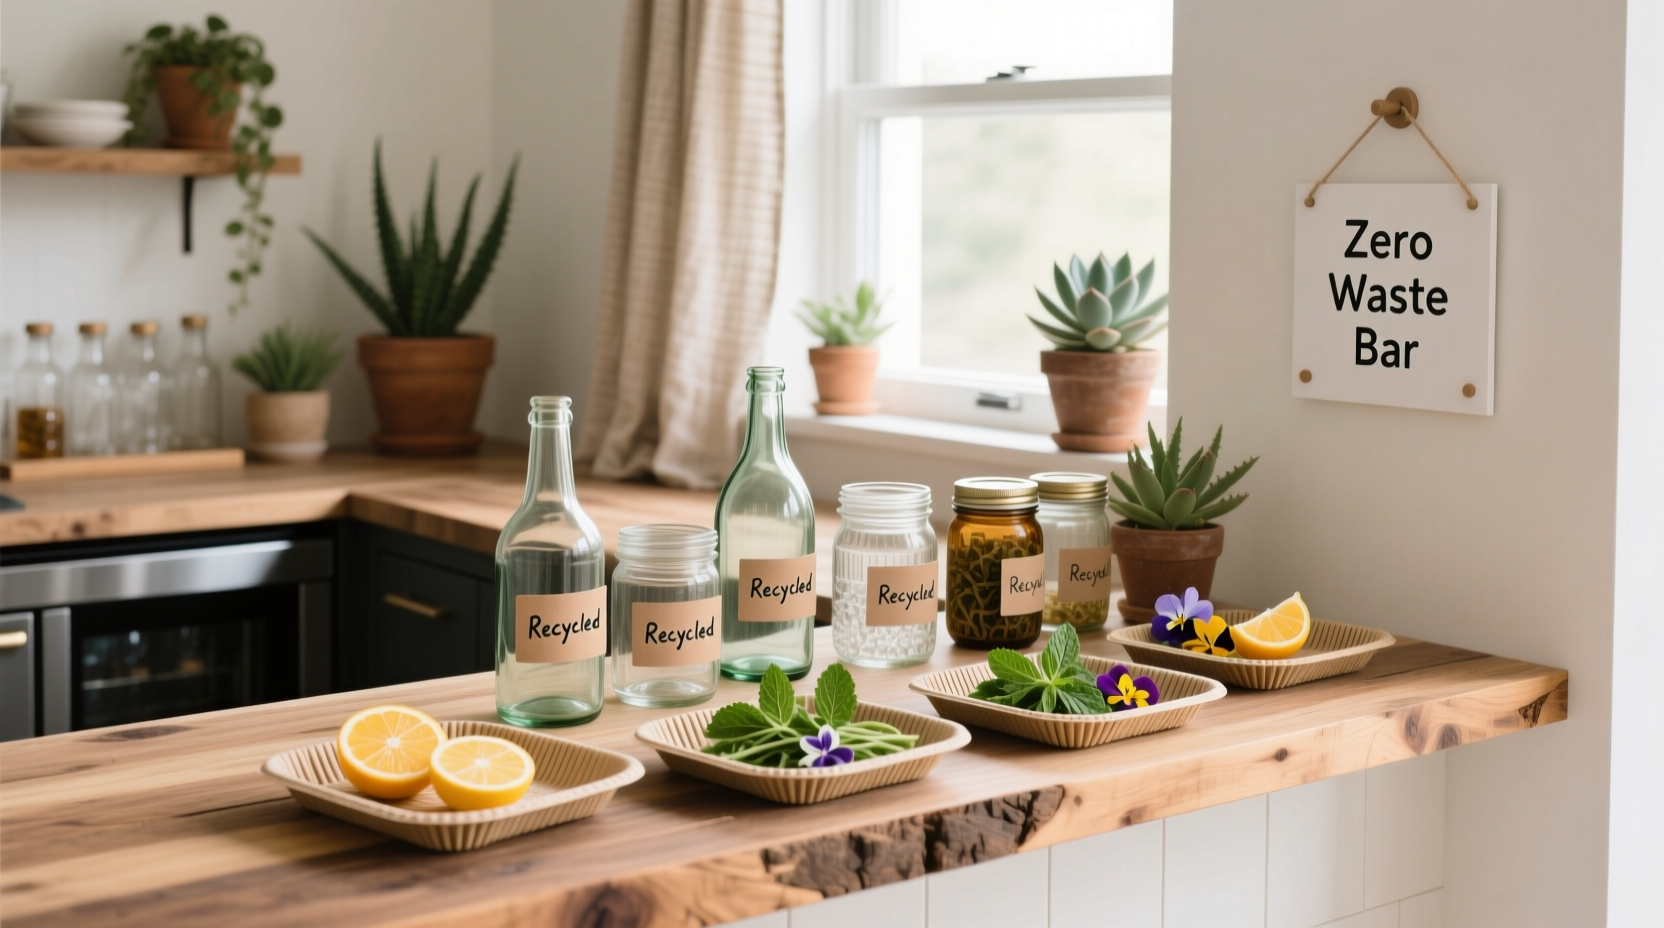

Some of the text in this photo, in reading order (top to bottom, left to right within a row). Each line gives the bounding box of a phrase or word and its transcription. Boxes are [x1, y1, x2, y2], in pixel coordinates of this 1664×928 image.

[1344, 219, 1433, 260] Zero
[1328, 272, 1448, 316] Waste
[1355, 326, 1419, 369] Bar
[750, 572, 813, 604] Recycled
[878, 579, 935, 610] Recycled
[528, 607, 601, 644] Recycled
[645, 615, 714, 650] Recycled
